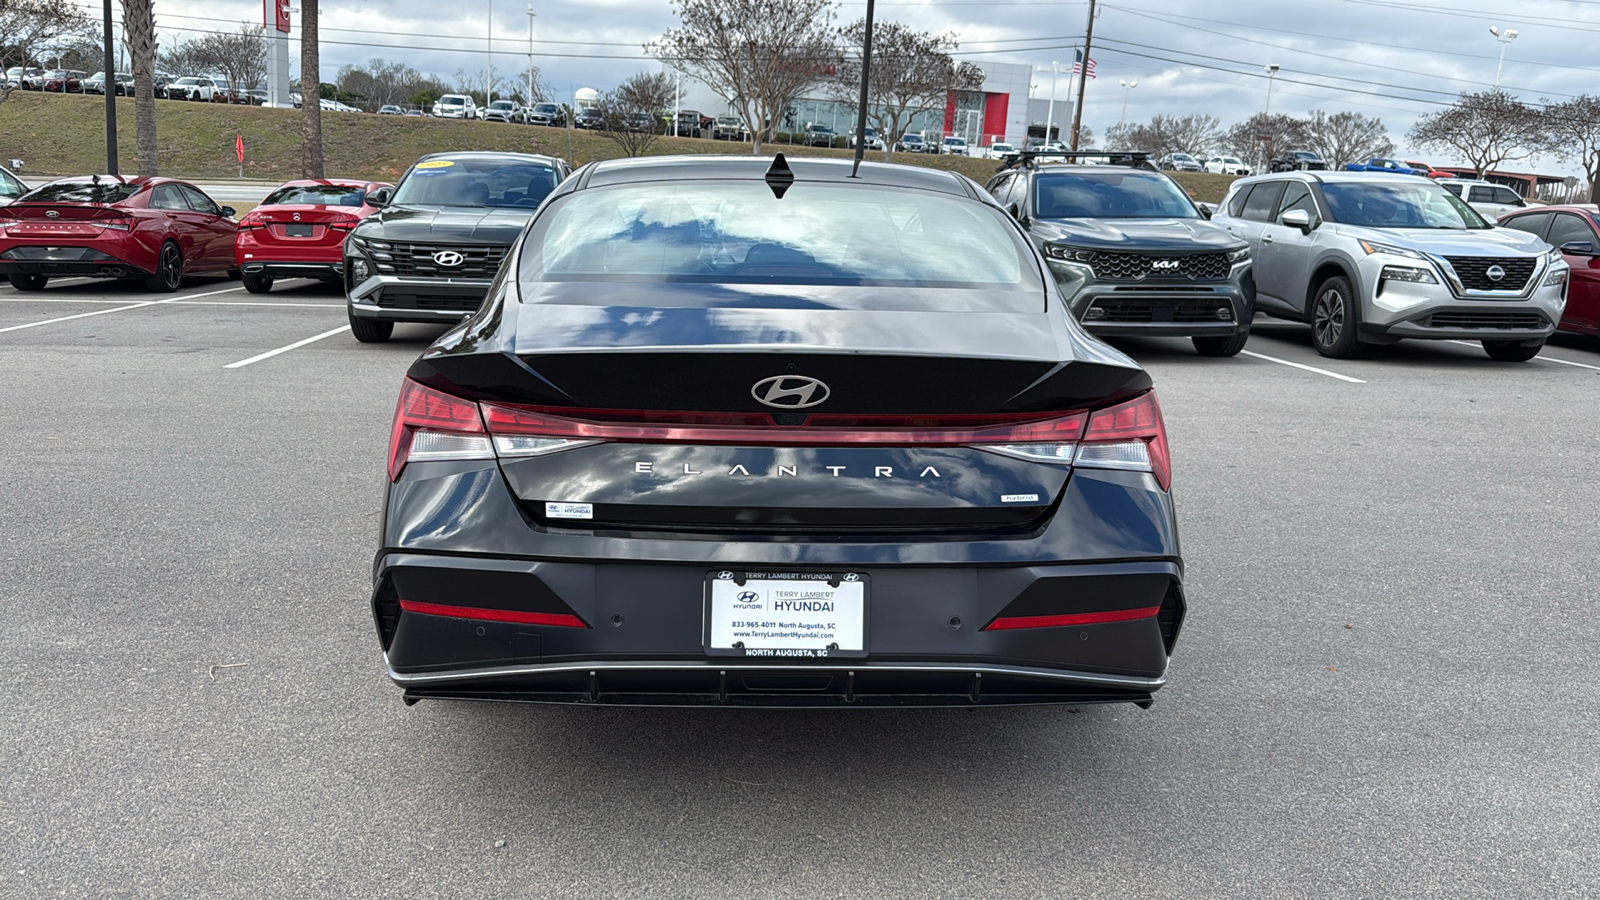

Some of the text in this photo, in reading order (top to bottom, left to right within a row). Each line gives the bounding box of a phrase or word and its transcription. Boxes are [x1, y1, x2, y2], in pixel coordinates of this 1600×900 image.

[1032, 119, 1058, 127] Servce
[1153, 260, 1180, 269] KIA
[635, 461, 941, 478] ELANTRA
[775, 590, 835, 599] TERRY LAMBERT
[774, 600, 834, 612] HYUNDAI
[798, 622, 826, 631] Augusta,
[733, 630, 834, 639] www.TerryLambertHyundai.com
[745, 649, 829, 658] NORTH AUGUSTA, SC
